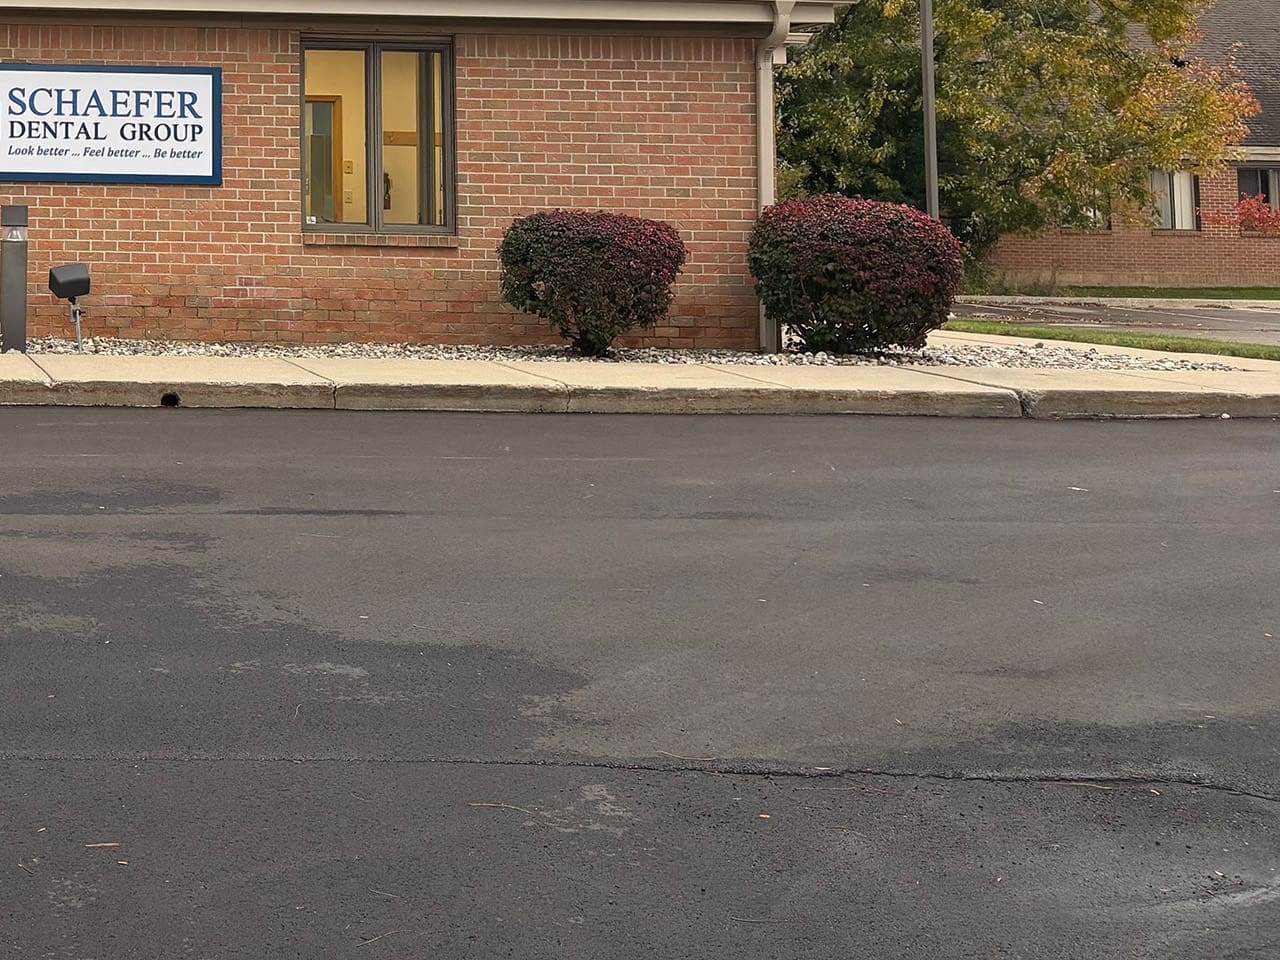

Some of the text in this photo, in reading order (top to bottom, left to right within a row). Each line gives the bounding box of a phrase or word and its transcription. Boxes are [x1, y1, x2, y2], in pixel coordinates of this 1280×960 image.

[8, 87, 203, 119] SCHAEFER
[8, 120, 204, 142] DENTAL GROUP
[8, 145, 35, 156] Look
[36, 145, 71, 157] better
[83, 146, 106, 158] Feel
[107, 146, 141, 158] better
[153, 147, 168, 159] Be
[169, 147, 204, 159] better
